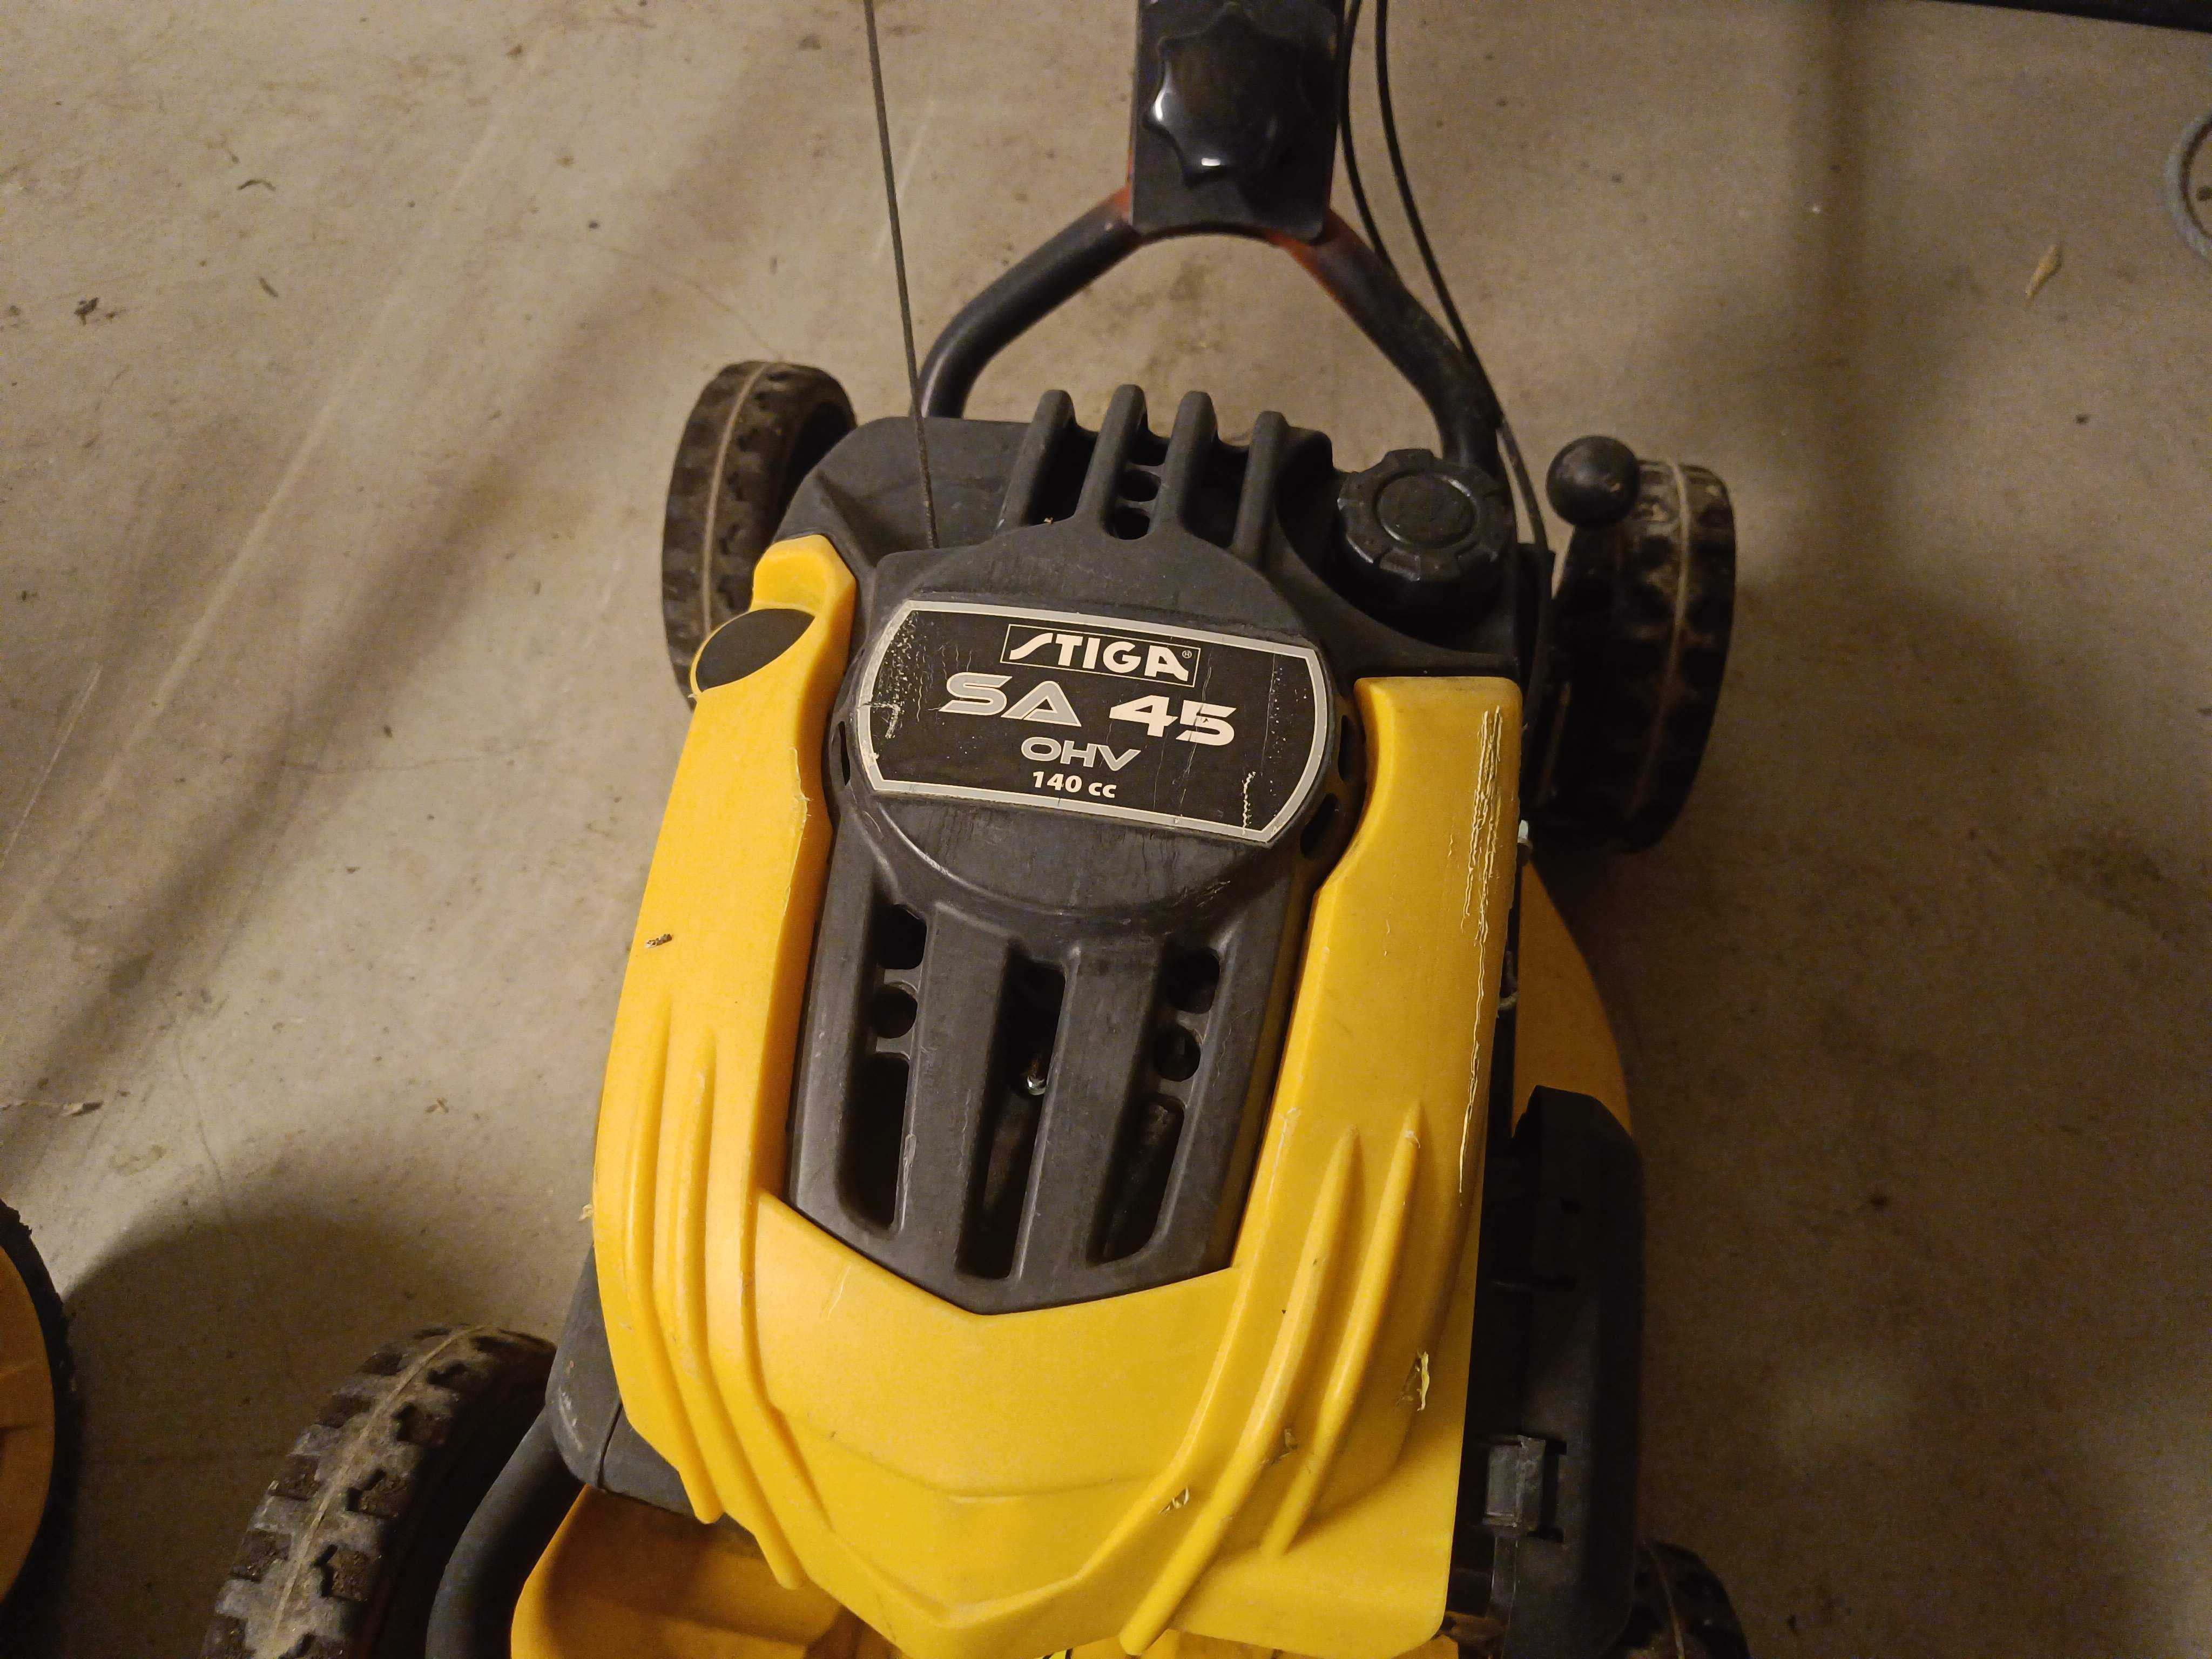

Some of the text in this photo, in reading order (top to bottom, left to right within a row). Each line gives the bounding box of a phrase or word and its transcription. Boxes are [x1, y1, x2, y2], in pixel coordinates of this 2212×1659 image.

[1009, 632, 1190, 682] STIGA
[937, 672, 1237, 746] SA 45
[1020, 736, 1142, 772] OHV
[1033, 771, 1117, 798] 140 cc
